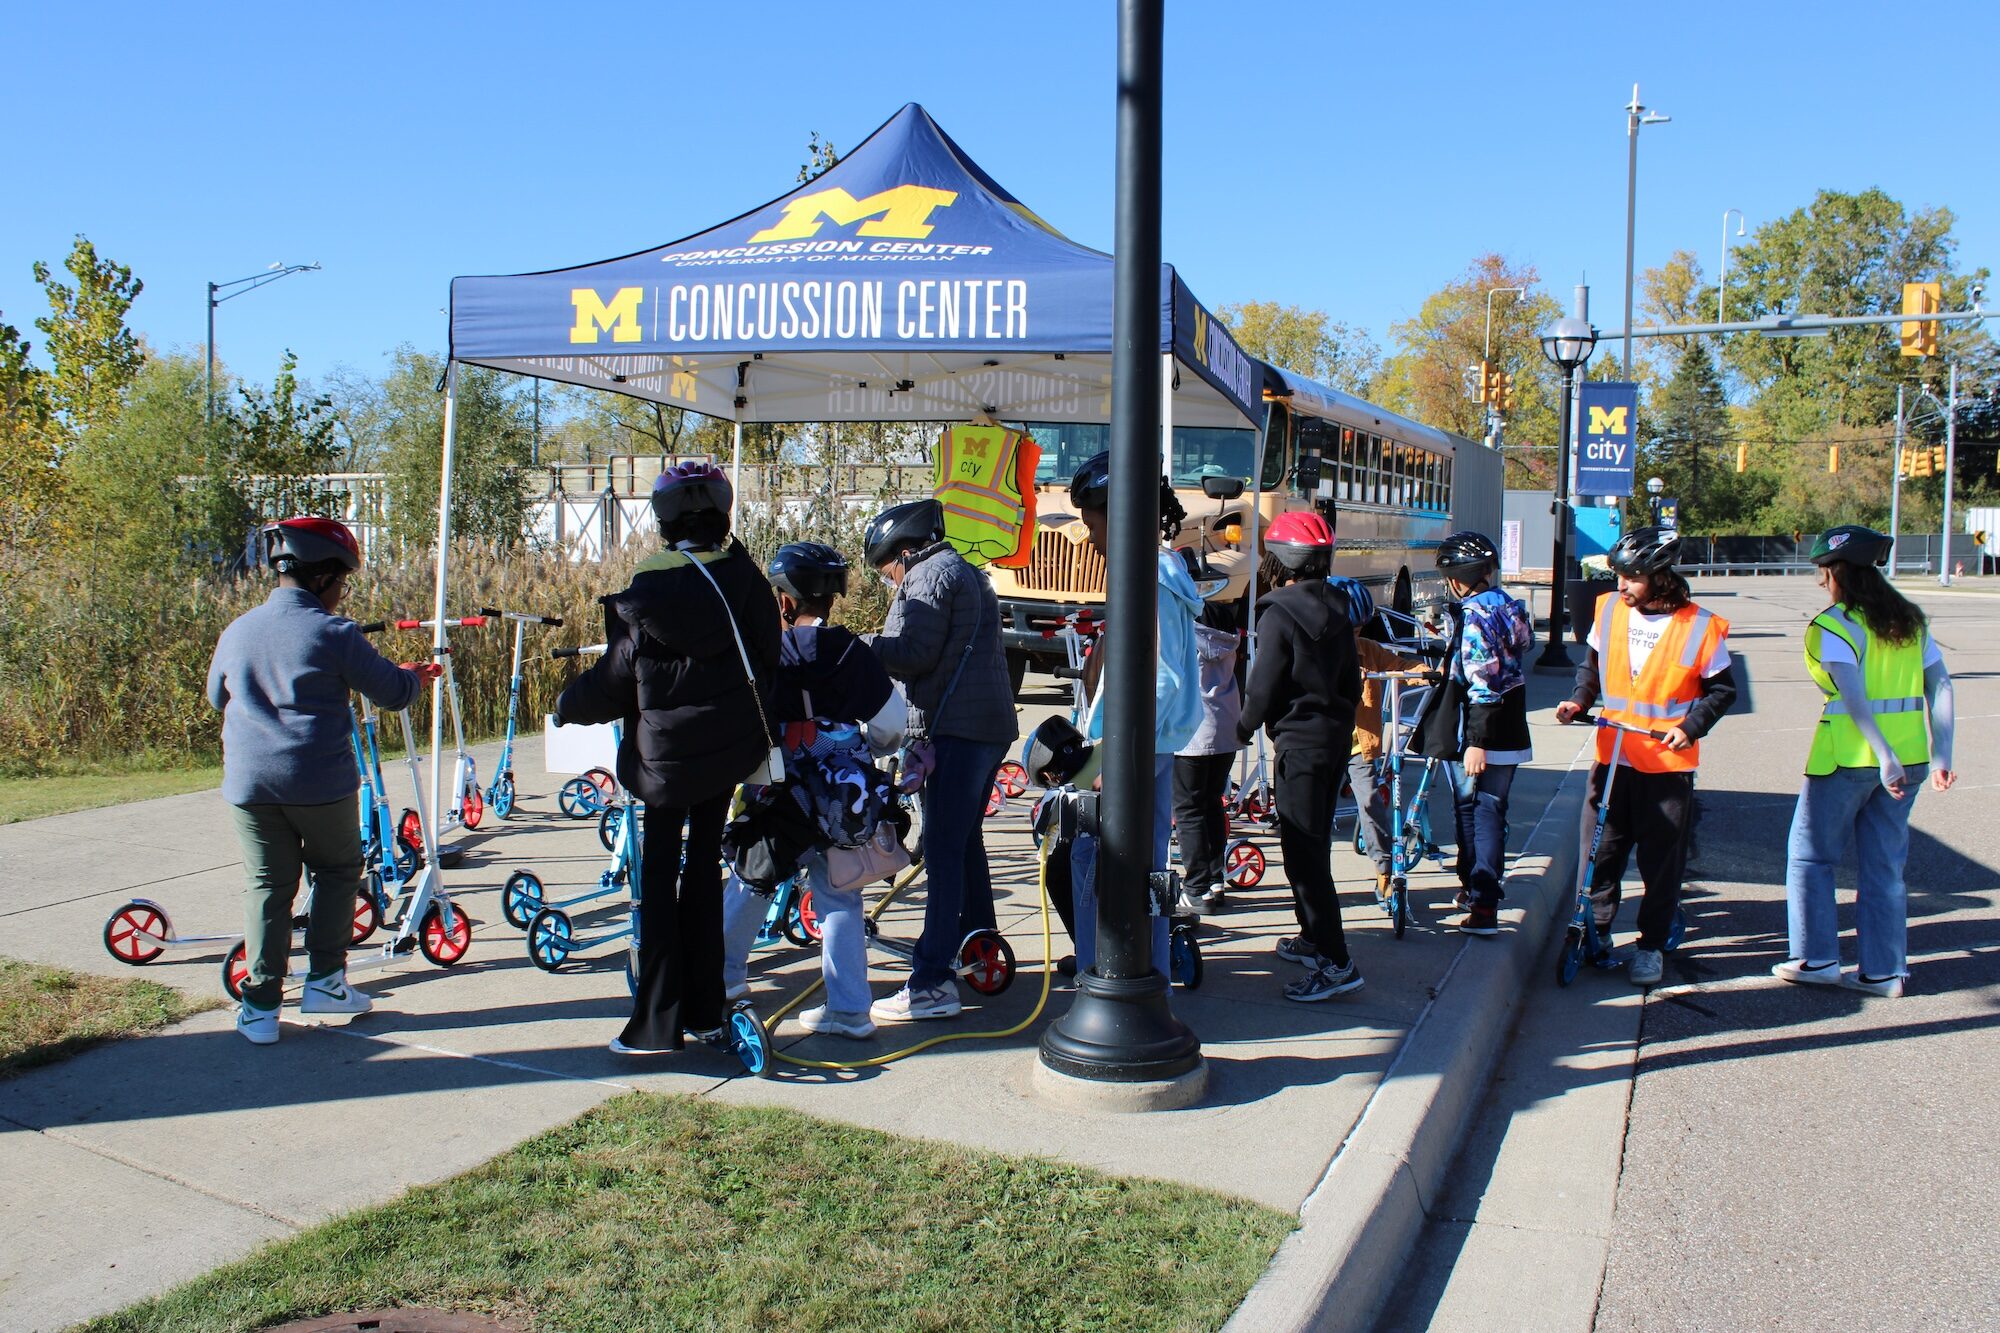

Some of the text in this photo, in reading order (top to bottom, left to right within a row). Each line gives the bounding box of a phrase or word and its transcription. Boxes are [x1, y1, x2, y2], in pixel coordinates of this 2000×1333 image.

[747, 184, 959, 243] M
[661, 240, 993, 263] CONCUSSION CENTER
[674, 254, 957, 267] UNIVERSITY OF MICHIGAN
[570, 280, 1027, 344] M CONCUSSION CENTER
[1588, 406, 1628, 435] M
[963, 437, 990, 458] M
[1586, 438, 1626, 465] city
[1627, 627, 1660, 640] POP-UP
[1587, 824, 1604, 861] Razor
